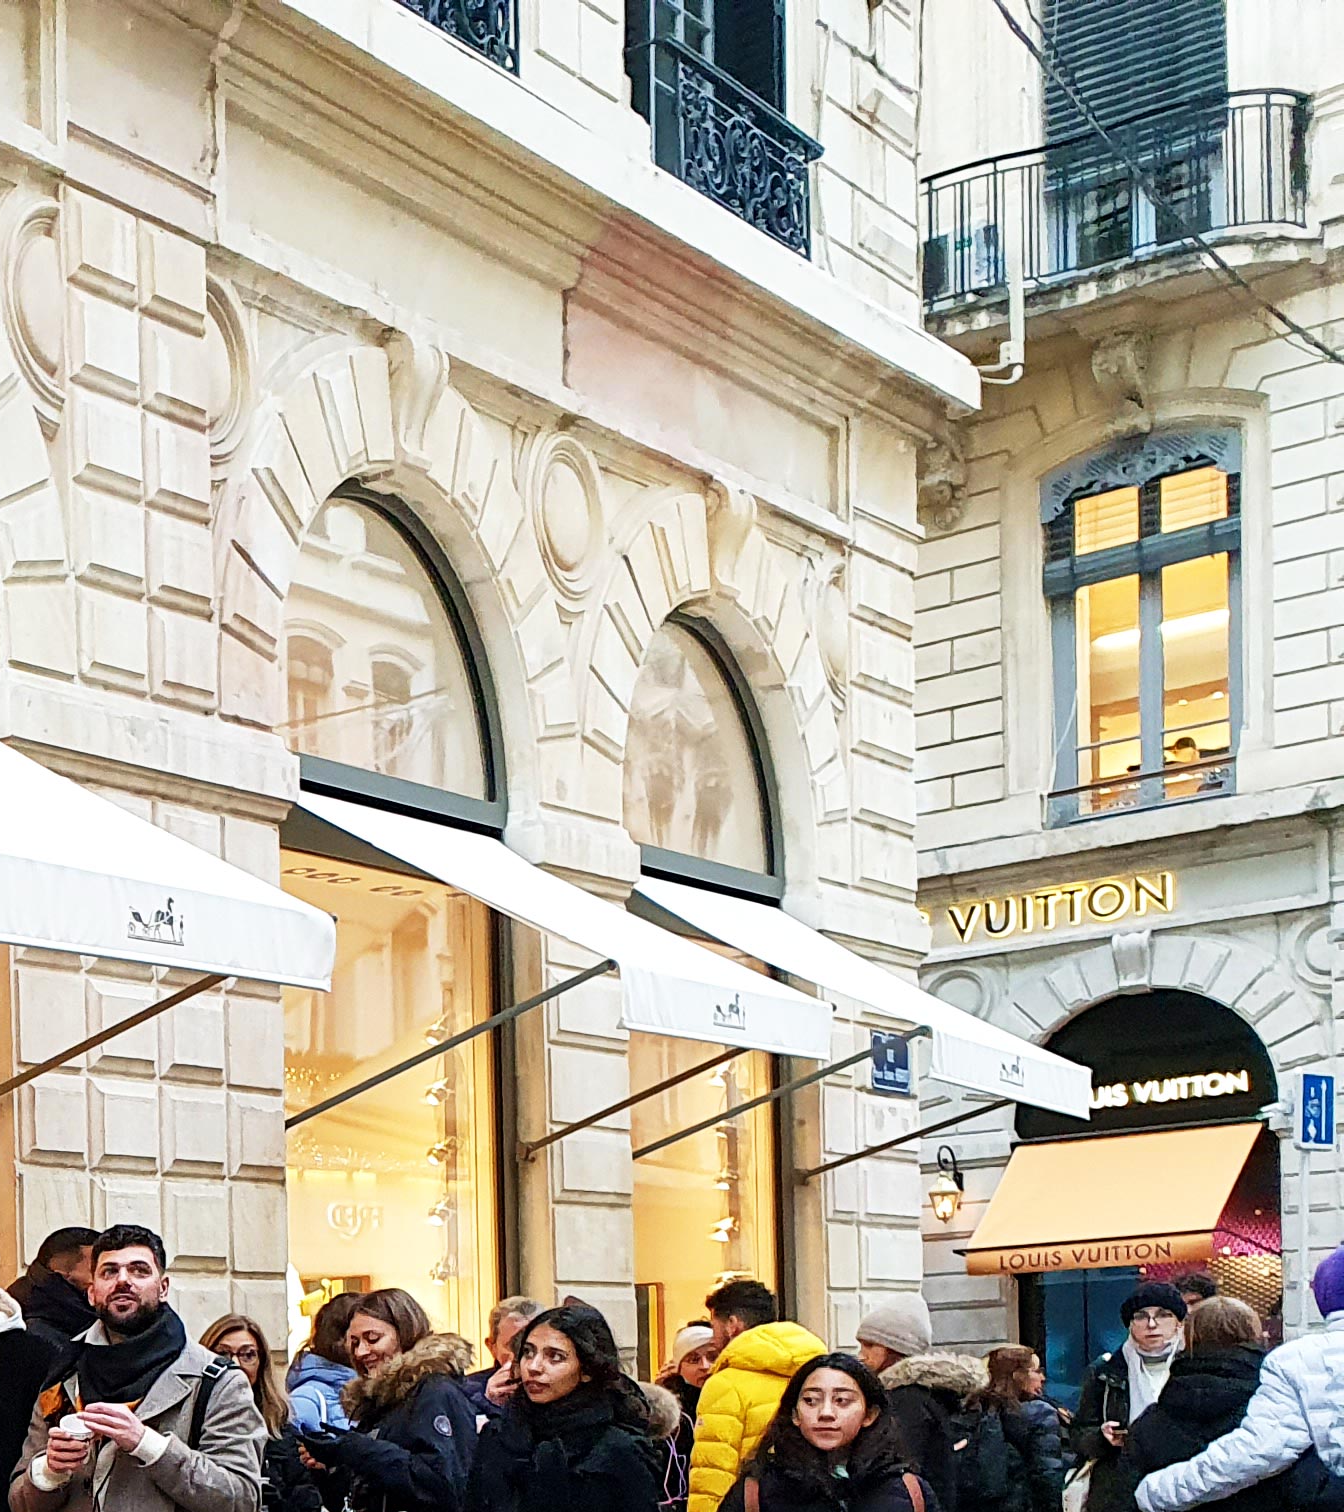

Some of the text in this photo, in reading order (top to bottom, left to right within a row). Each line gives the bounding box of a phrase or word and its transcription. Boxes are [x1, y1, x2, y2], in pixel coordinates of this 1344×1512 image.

[948, 872, 1174, 944] VUITTON
[1132, 1069, 1249, 1104] VUITTON
[1000, 1241, 1172, 1271] LOUIS VUITTON
